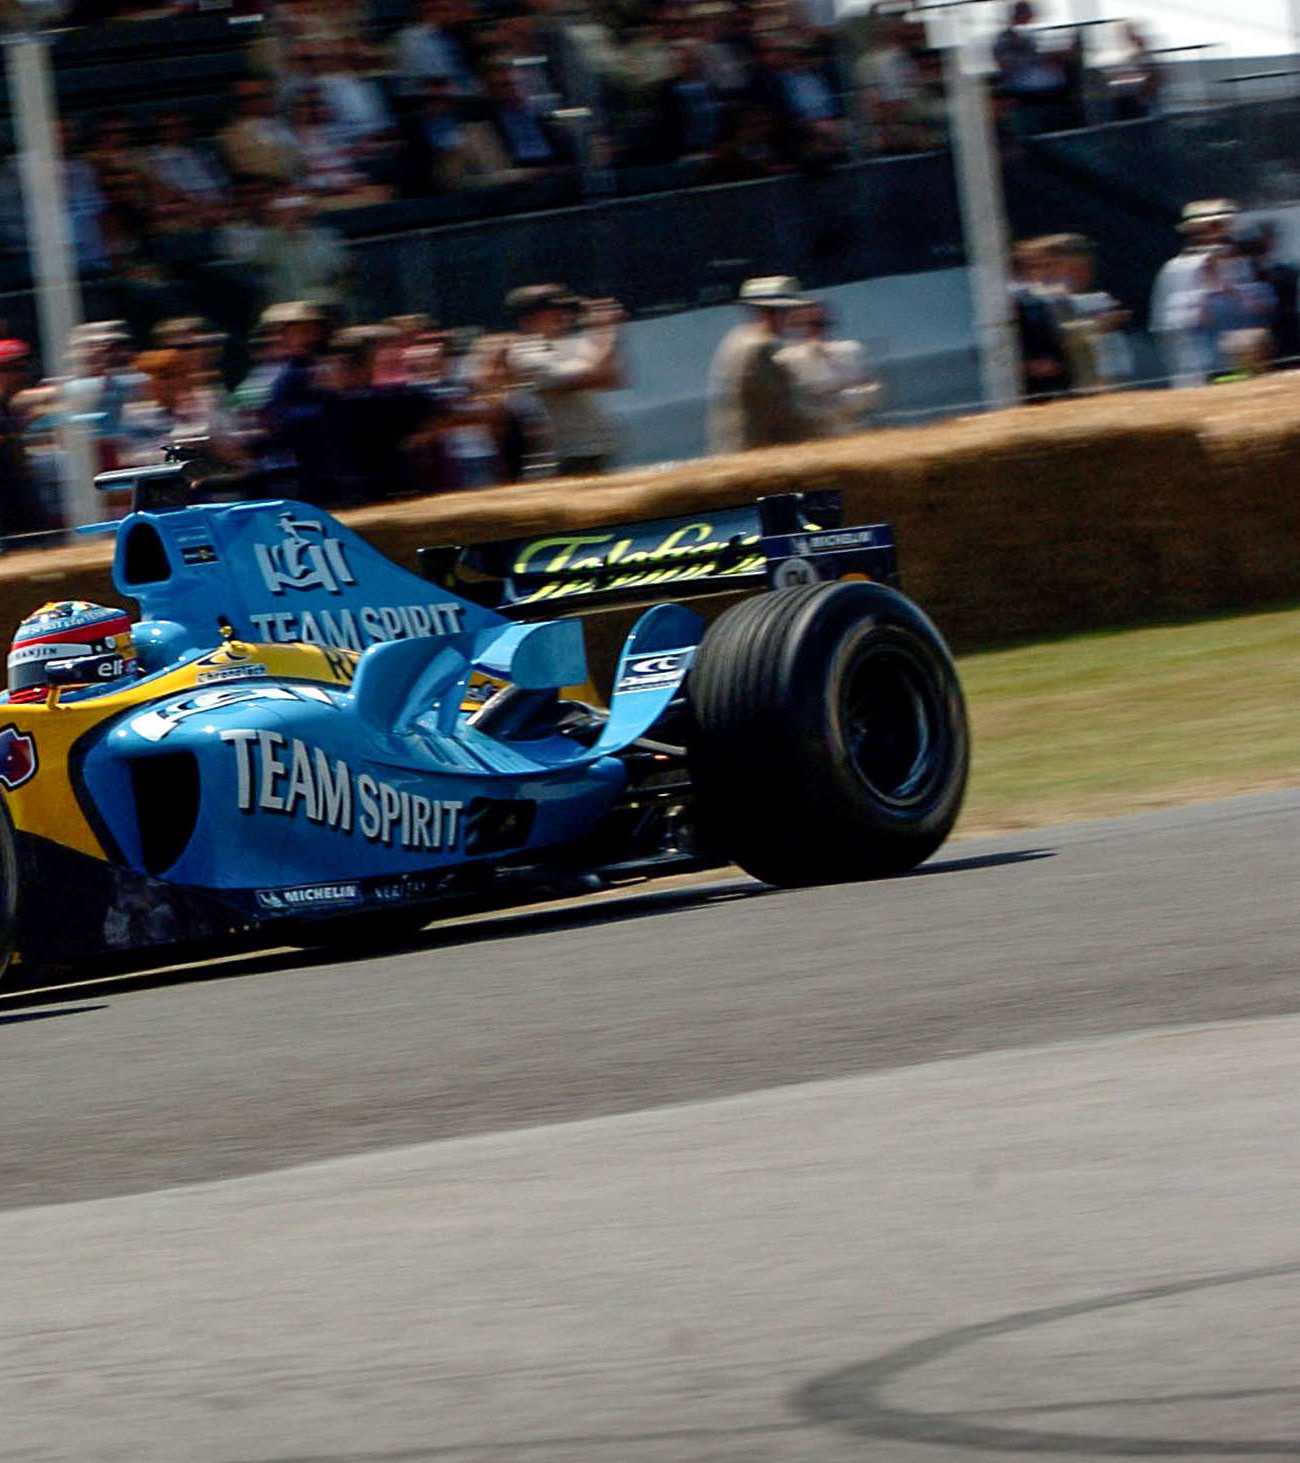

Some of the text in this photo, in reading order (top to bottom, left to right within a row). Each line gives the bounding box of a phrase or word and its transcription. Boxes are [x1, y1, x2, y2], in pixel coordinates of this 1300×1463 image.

[251, 603, 464, 652] TEAM SPIRIT
[97, 658, 124, 678] elf
[220, 729, 464, 848] TEAM SPIRIT
[284, 885, 356, 902] MICHELIN
